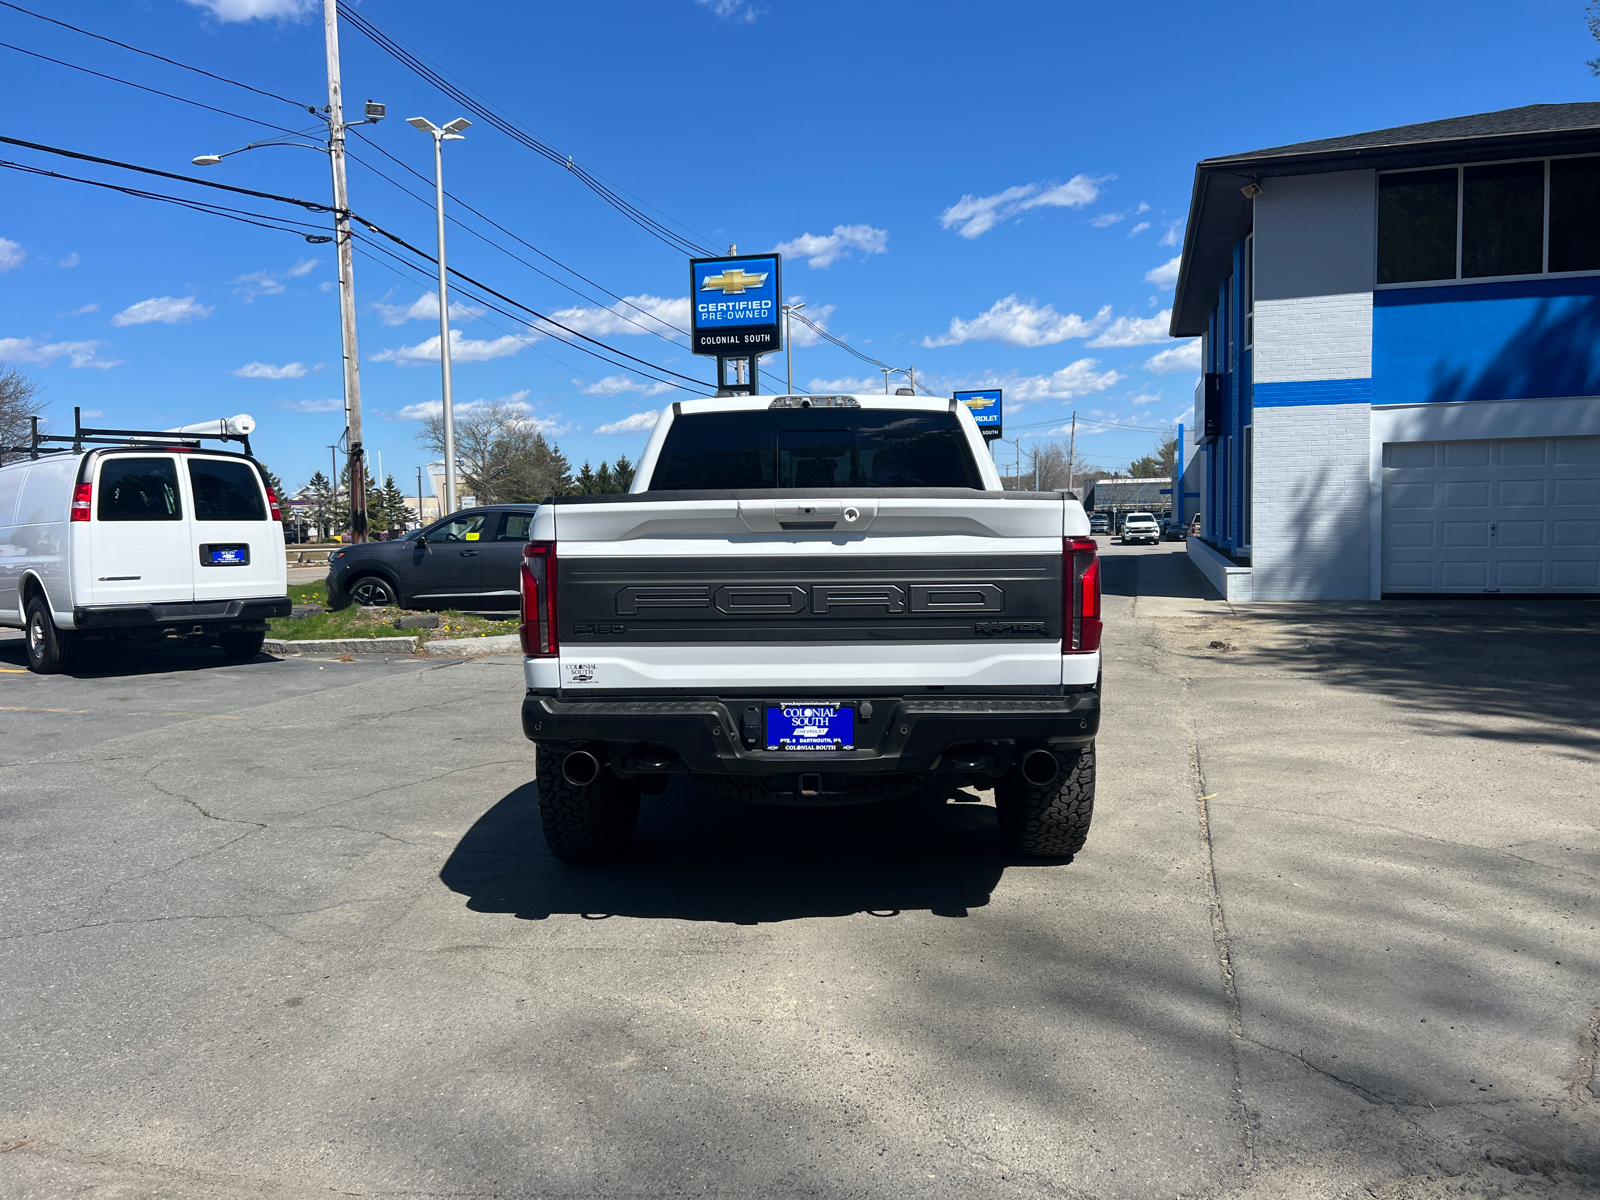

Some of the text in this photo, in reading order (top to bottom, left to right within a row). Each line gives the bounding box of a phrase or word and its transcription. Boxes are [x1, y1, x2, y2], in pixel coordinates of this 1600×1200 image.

[698, 300, 771, 312] CERTIFIED
[702, 309, 768, 320] PRE-OWNED
[700, 334, 771, 345] COLONIAL SOUTH
[615, 584, 1004, 615] FORD
[975, 621, 1051, 637] RAPTOR
[783, 708, 837, 717] COLONIAL
[792, 717, 829, 726] SOUTH
